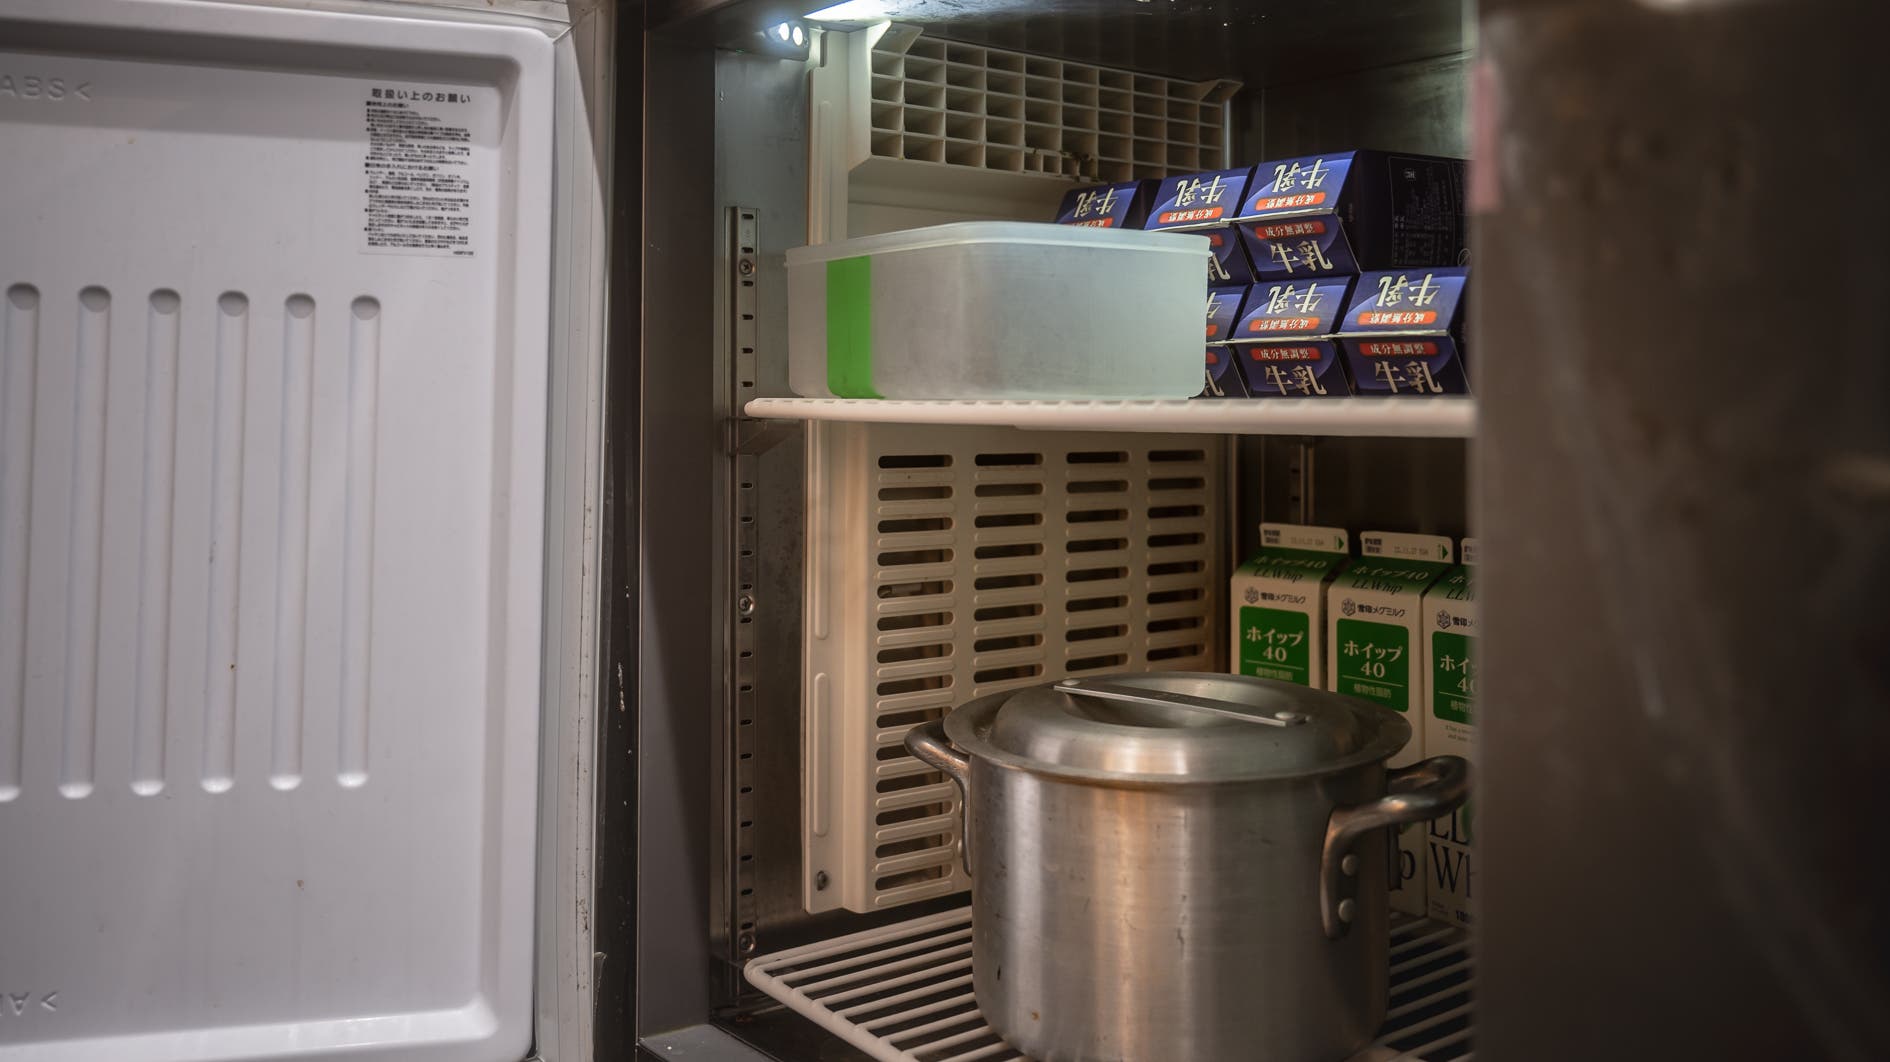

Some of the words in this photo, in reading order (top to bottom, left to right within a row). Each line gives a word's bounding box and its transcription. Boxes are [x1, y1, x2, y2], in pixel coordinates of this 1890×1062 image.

[371, 87, 471, 104] 取扱い上のお願い
[1272, 158, 1329, 193] 牛乳
[1175, 175, 1227, 207] 牛乳
[1073, 187, 1119, 218] 牛乳
[1265, 193, 1316, 209] 成分無調整
[1168, 209, 1214, 222] 成分無調整
[1265, 222, 1316, 239] 成分無調整
[1208, 252, 1231, 281] 乳
[1270, 239, 1334, 275] 牛乳
[1265, 282, 1324, 315] 牛乳
[1376, 273, 1441, 308] 牛乳
[1259, 318, 1310, 331] 成分無調整
[1369, 311, 1426, 325] 成分無調整
[1260, 348, 1310, 361] 成分無調整
[1369, 342, 1426, 356] 成分無調整
[1264, 364, 1328, 396] 牛乳
[1374, 360, 1444, 394] 牛乳
[1260, 591, 1306, 605] 雪印メグミルク
[1356, 603, 1406, 618] 雪印メグミルク
[1245, 625, 1305, 648] ホイップ
[1262, 646, 1288, 663] 40
[1343, 639, 1403, 663] ホイップ
[1359, 660, 1386, 679] 40
